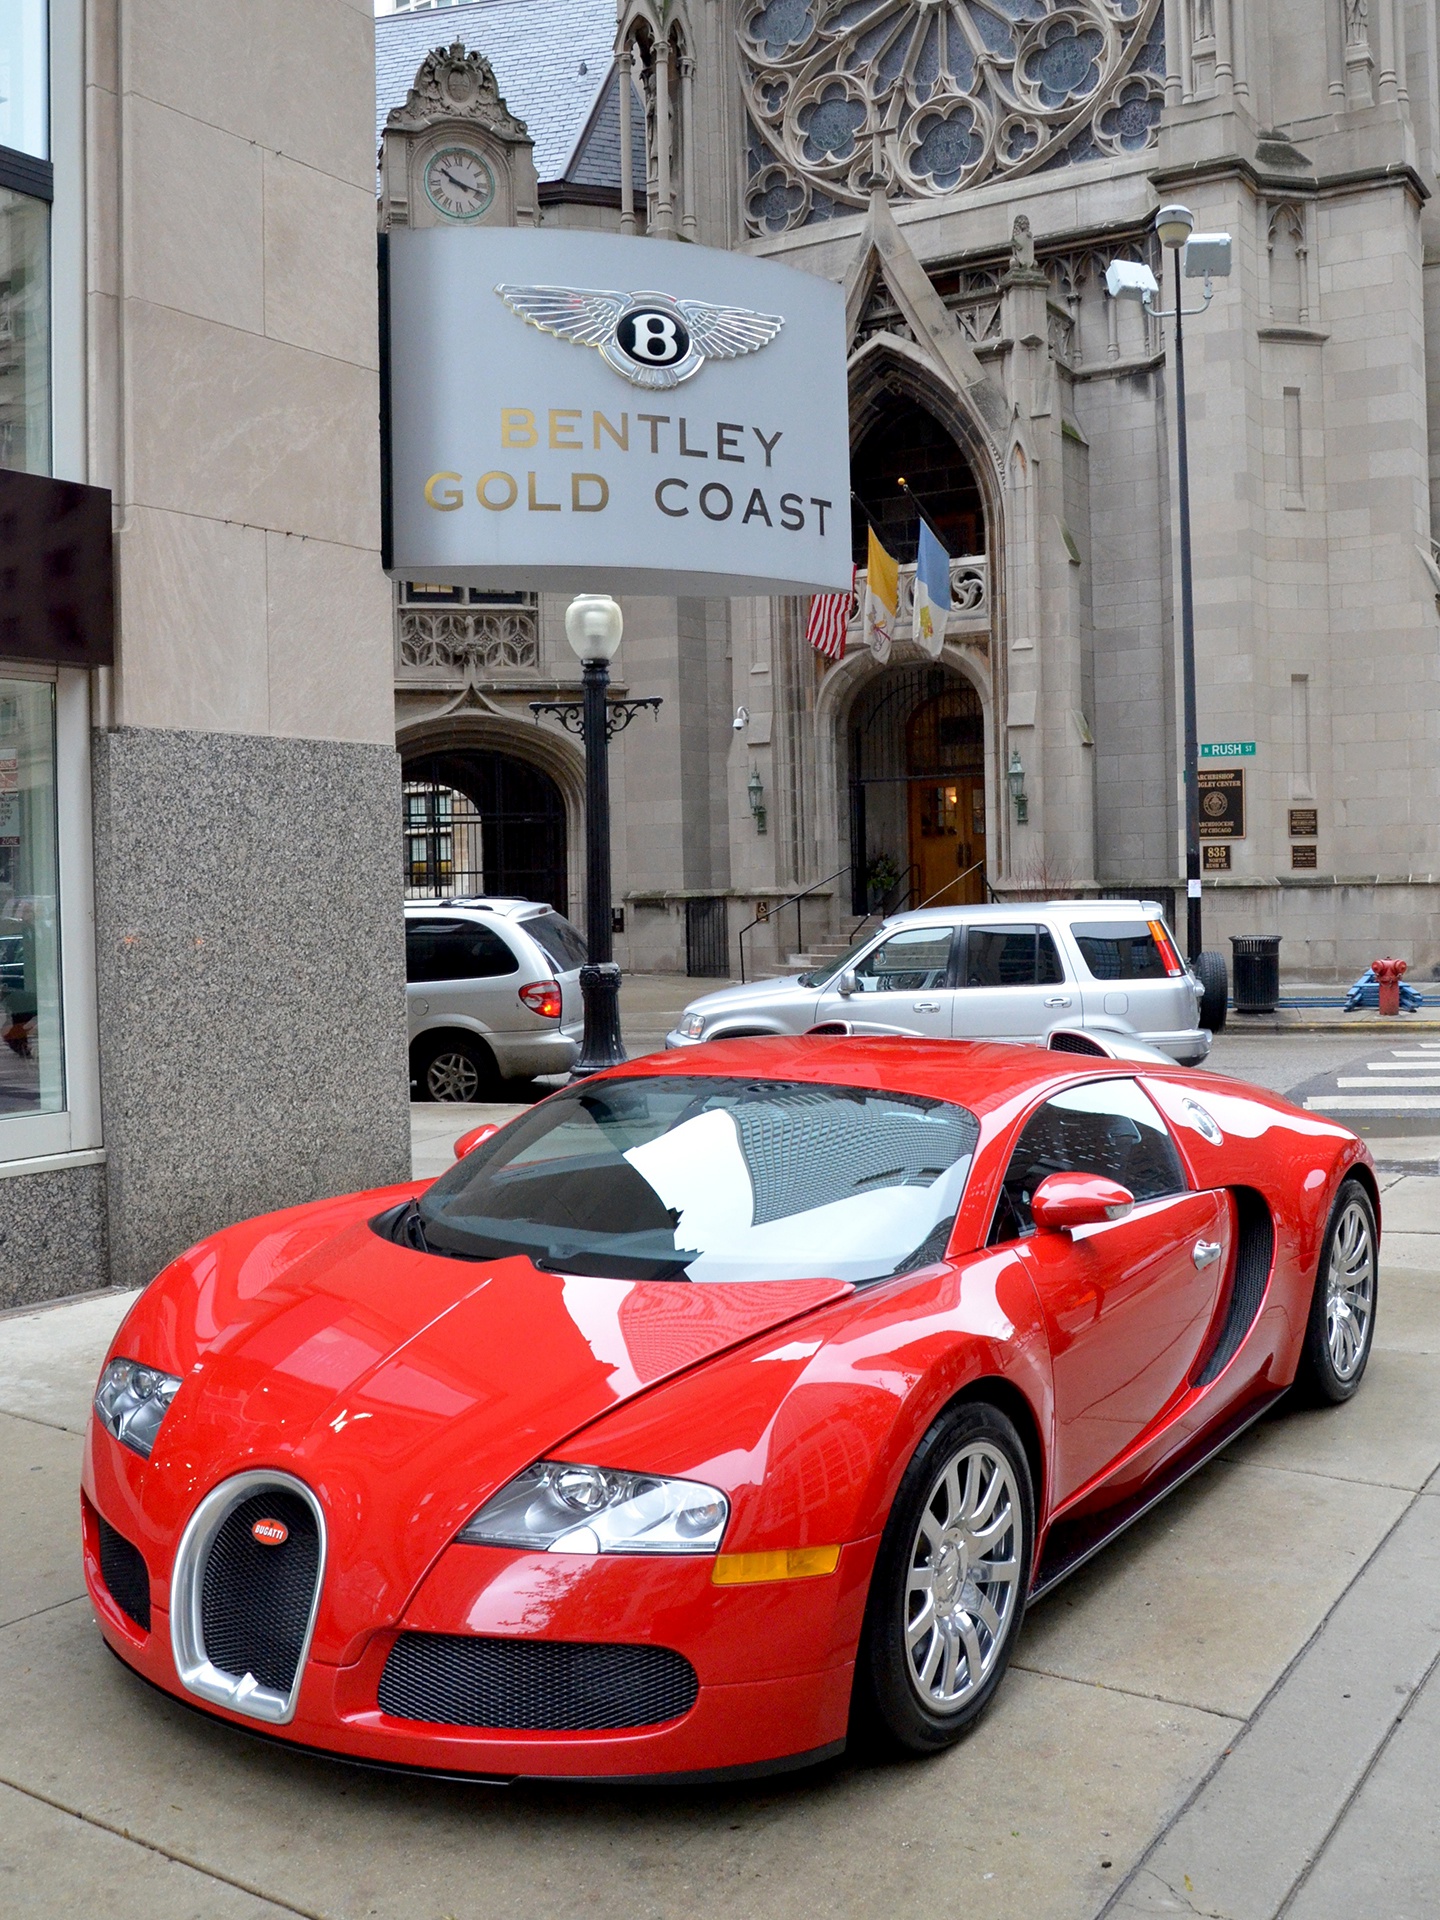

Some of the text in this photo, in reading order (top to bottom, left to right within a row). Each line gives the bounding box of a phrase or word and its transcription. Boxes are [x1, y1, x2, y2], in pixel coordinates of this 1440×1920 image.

[632, 313, 678, 361] B
[501, 408, 783, 468] BENTLEY
[424, 471, 832, 536] GOLD COAST
[1212, 744, 1242, 755] RUSH
[1207, 847, 1226, 857] 835
[255, 1525, 283, 1540] BUGATTI
